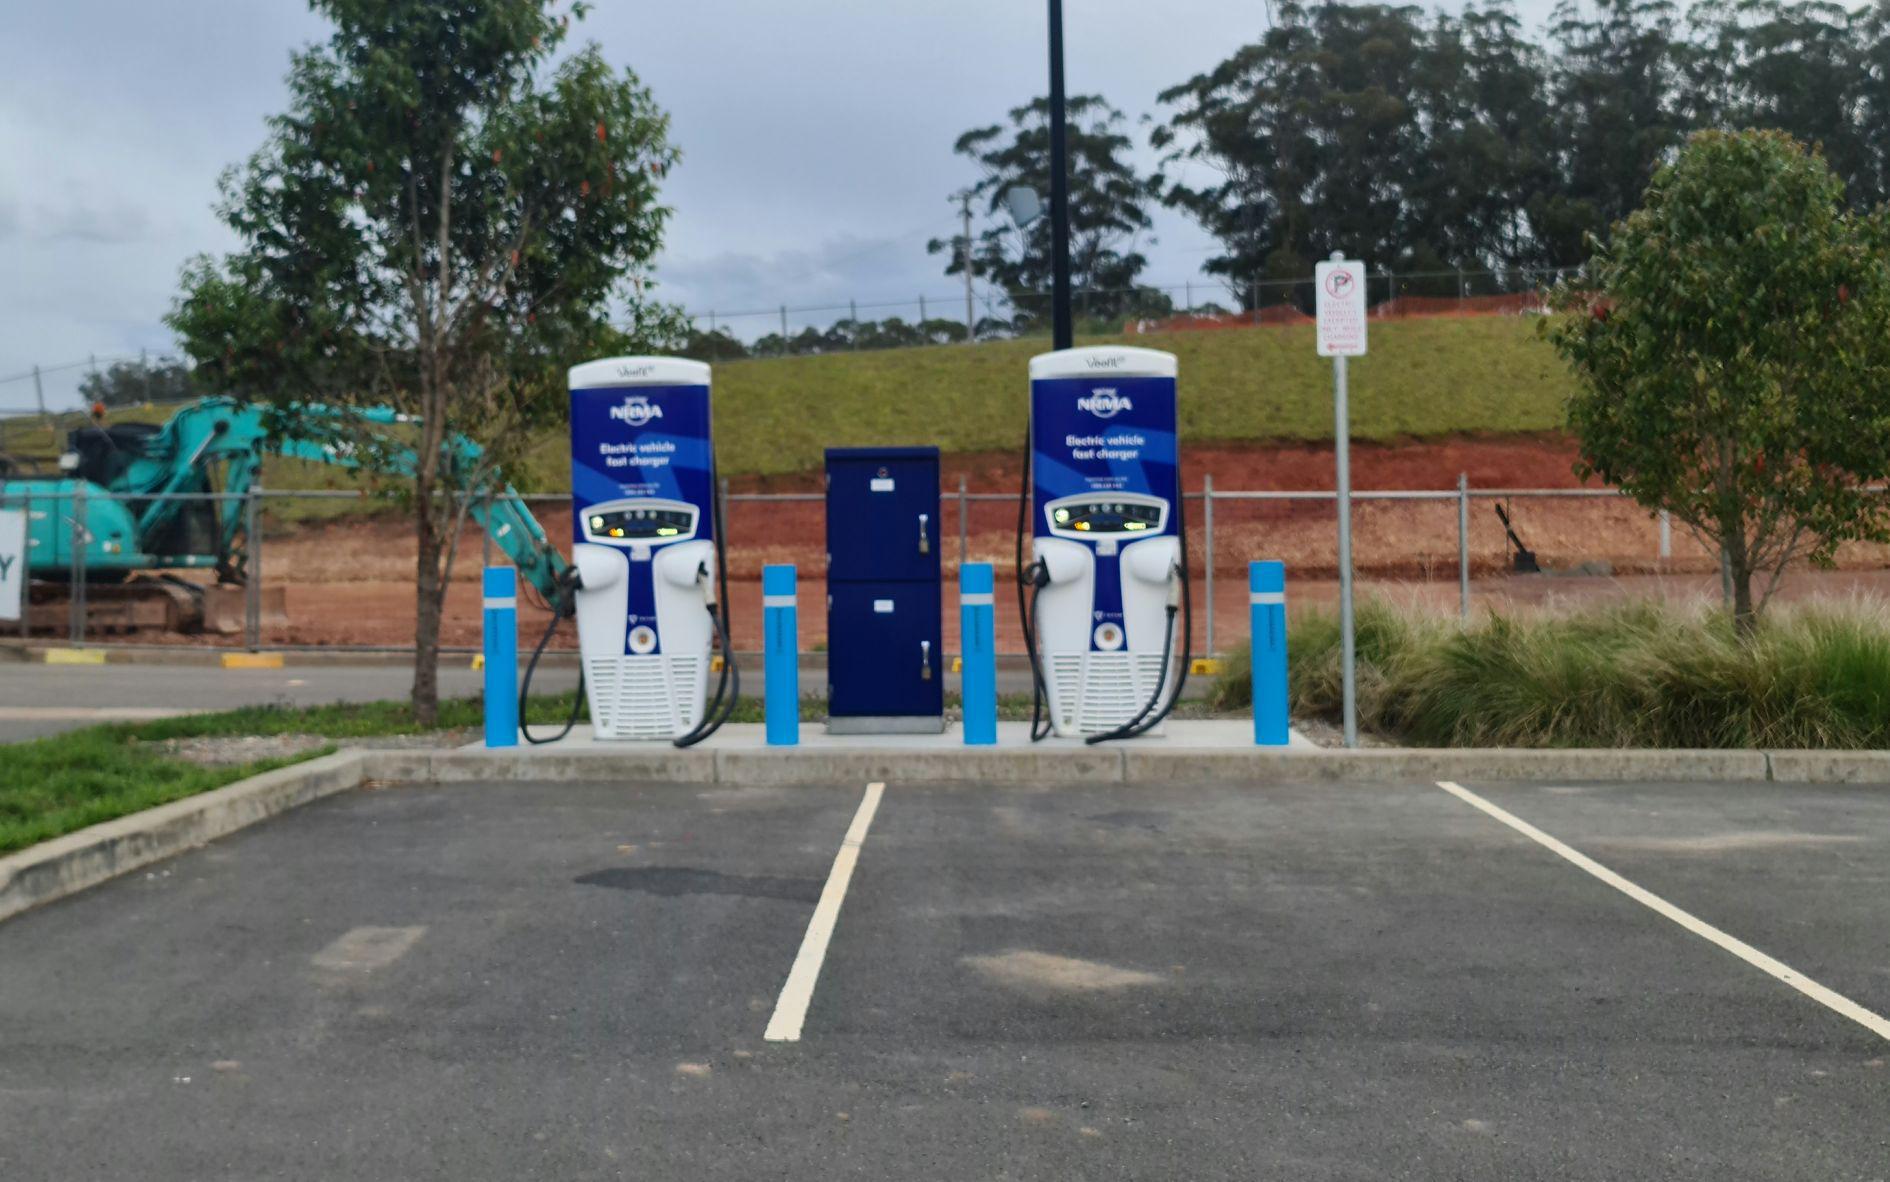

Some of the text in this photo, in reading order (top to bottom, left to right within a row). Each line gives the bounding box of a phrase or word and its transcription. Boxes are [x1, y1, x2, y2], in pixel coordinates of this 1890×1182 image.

[1077, 396, 1132, 411] NRMA
[610, 404, 663, 419] NRMA
[1065, 434, 1145, 446] Electric vehicle
[599, 441, 676, 454] Electric vehicle
[1072, 448, 1138, 461] fast charger
[605, 455, 670, 468] fast charger
